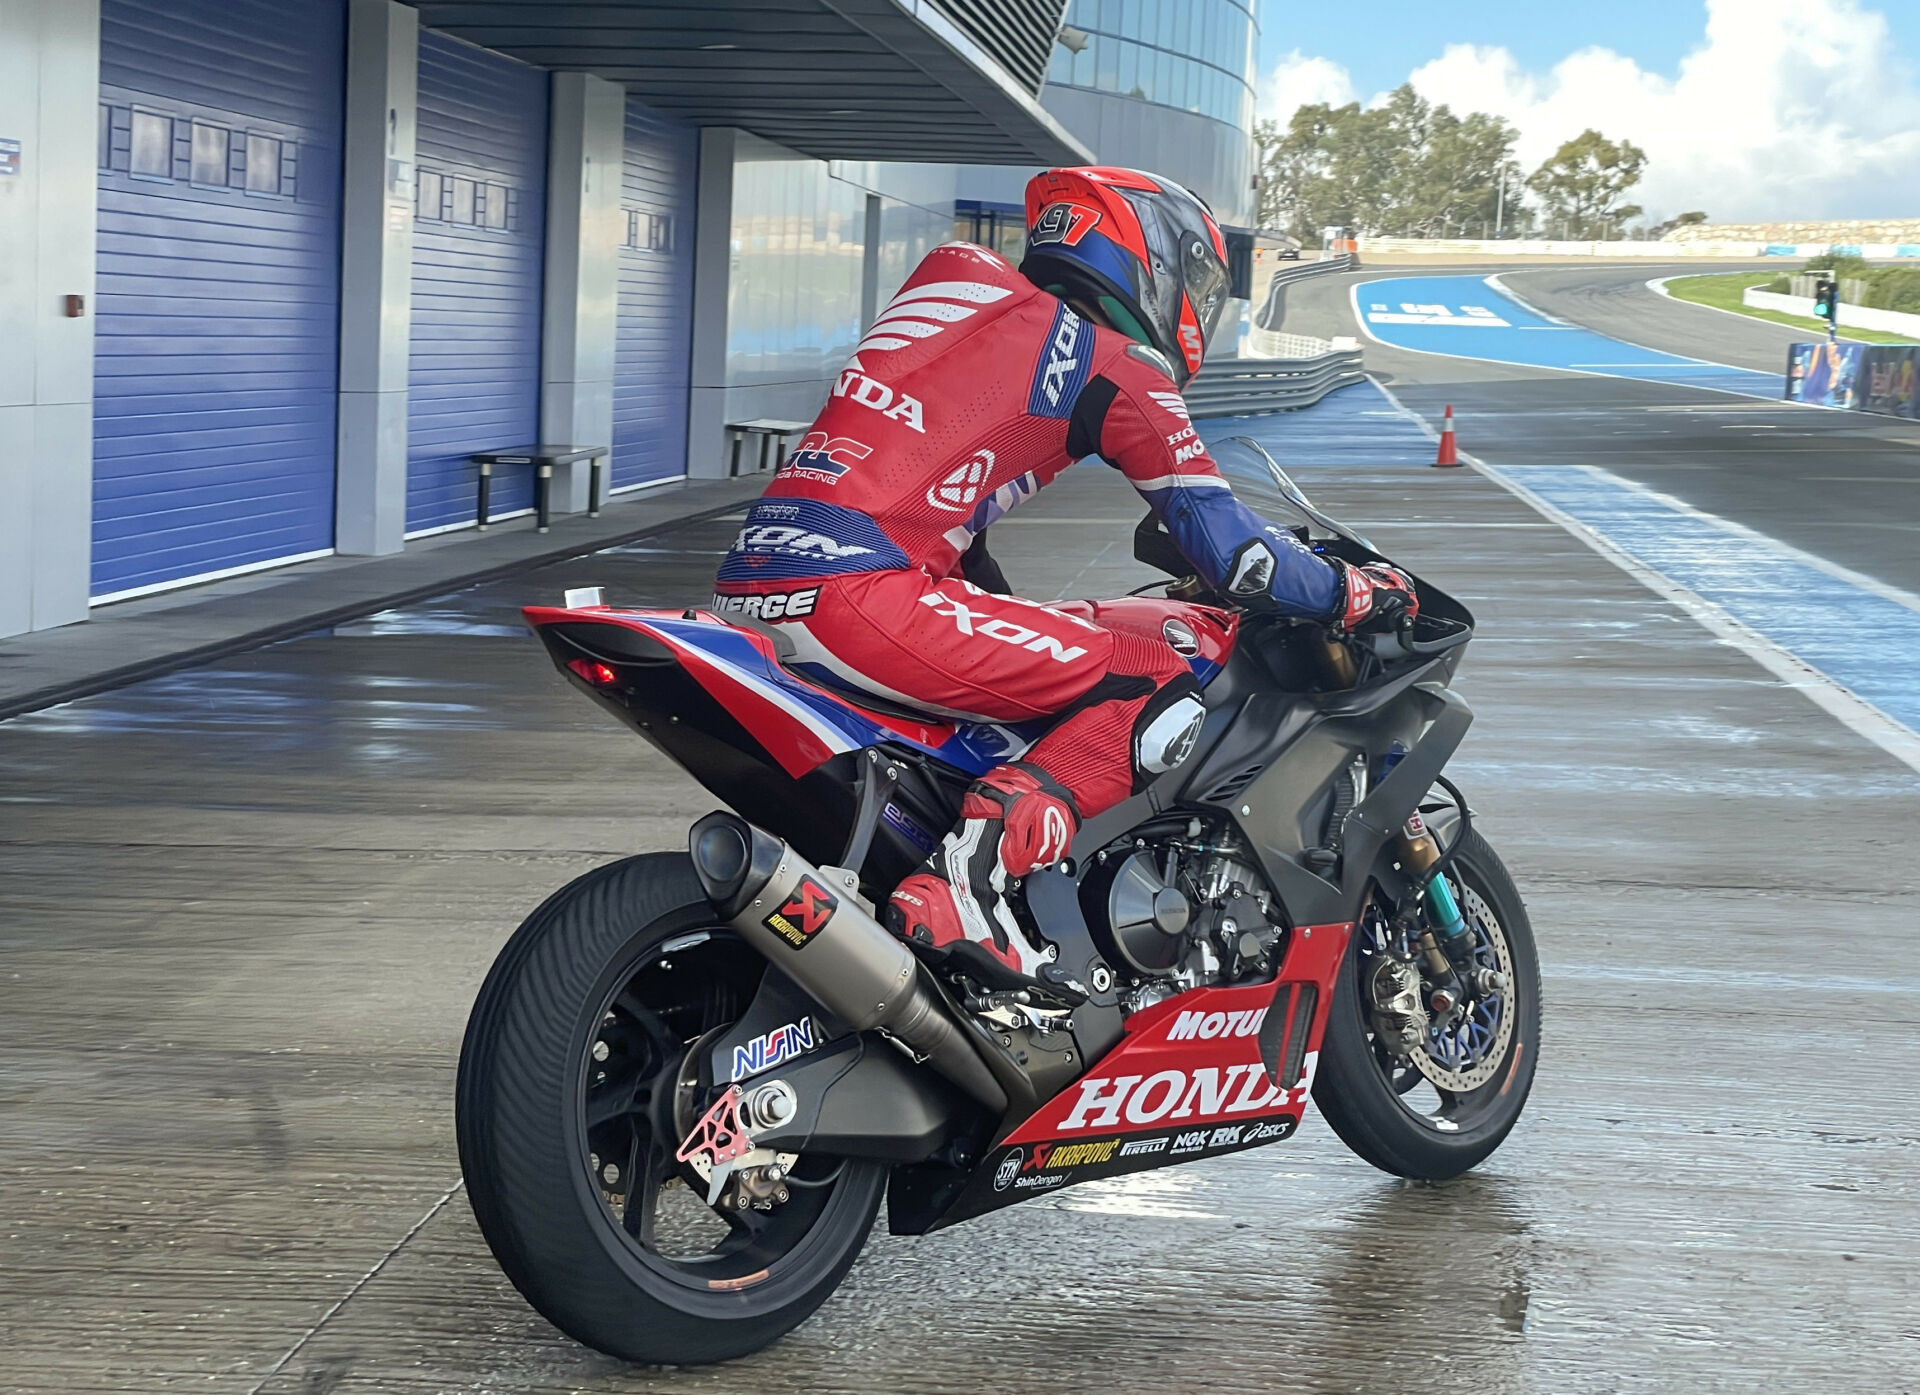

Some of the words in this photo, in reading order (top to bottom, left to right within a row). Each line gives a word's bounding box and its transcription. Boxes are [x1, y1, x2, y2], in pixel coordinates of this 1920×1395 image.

[1030, 202, 1102, 247] 97
[792, 470, 839, 486] RACING
[918, 591, 1089, 663] IXON
[1172, 1129, 1211, 1149] NGK
[1208, 1125, 1246, 1147] RK
[1119, 1137, 1170, 1157] PIRELLI
[1014, 1174, 1063, 1188] ShinDengen
